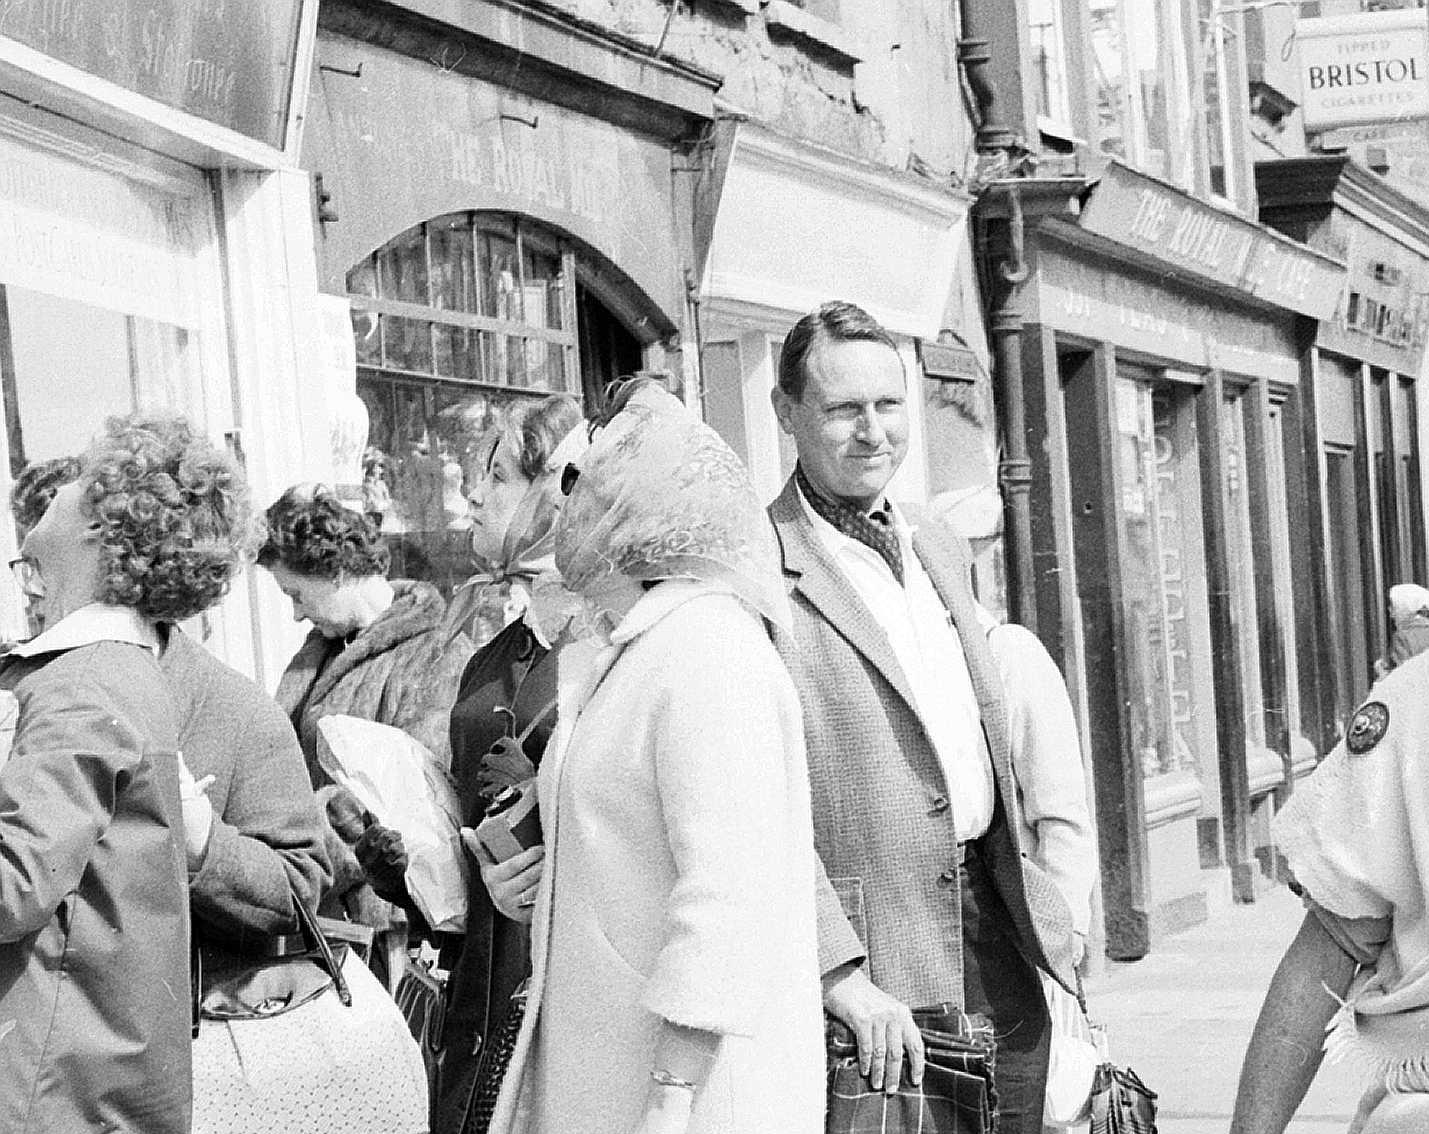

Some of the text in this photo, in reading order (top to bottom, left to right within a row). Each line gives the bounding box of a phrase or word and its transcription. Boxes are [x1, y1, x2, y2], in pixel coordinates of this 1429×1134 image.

[1338, 40, 1391, 54] TIPPED
[1309, 57, 1423, 89] BRISTOL
[1321, 91, 1413, 108] CIGARETTES
[1131, 188, 1172, 242] THE
[1169, 206, 1229, 268] ROYAL
